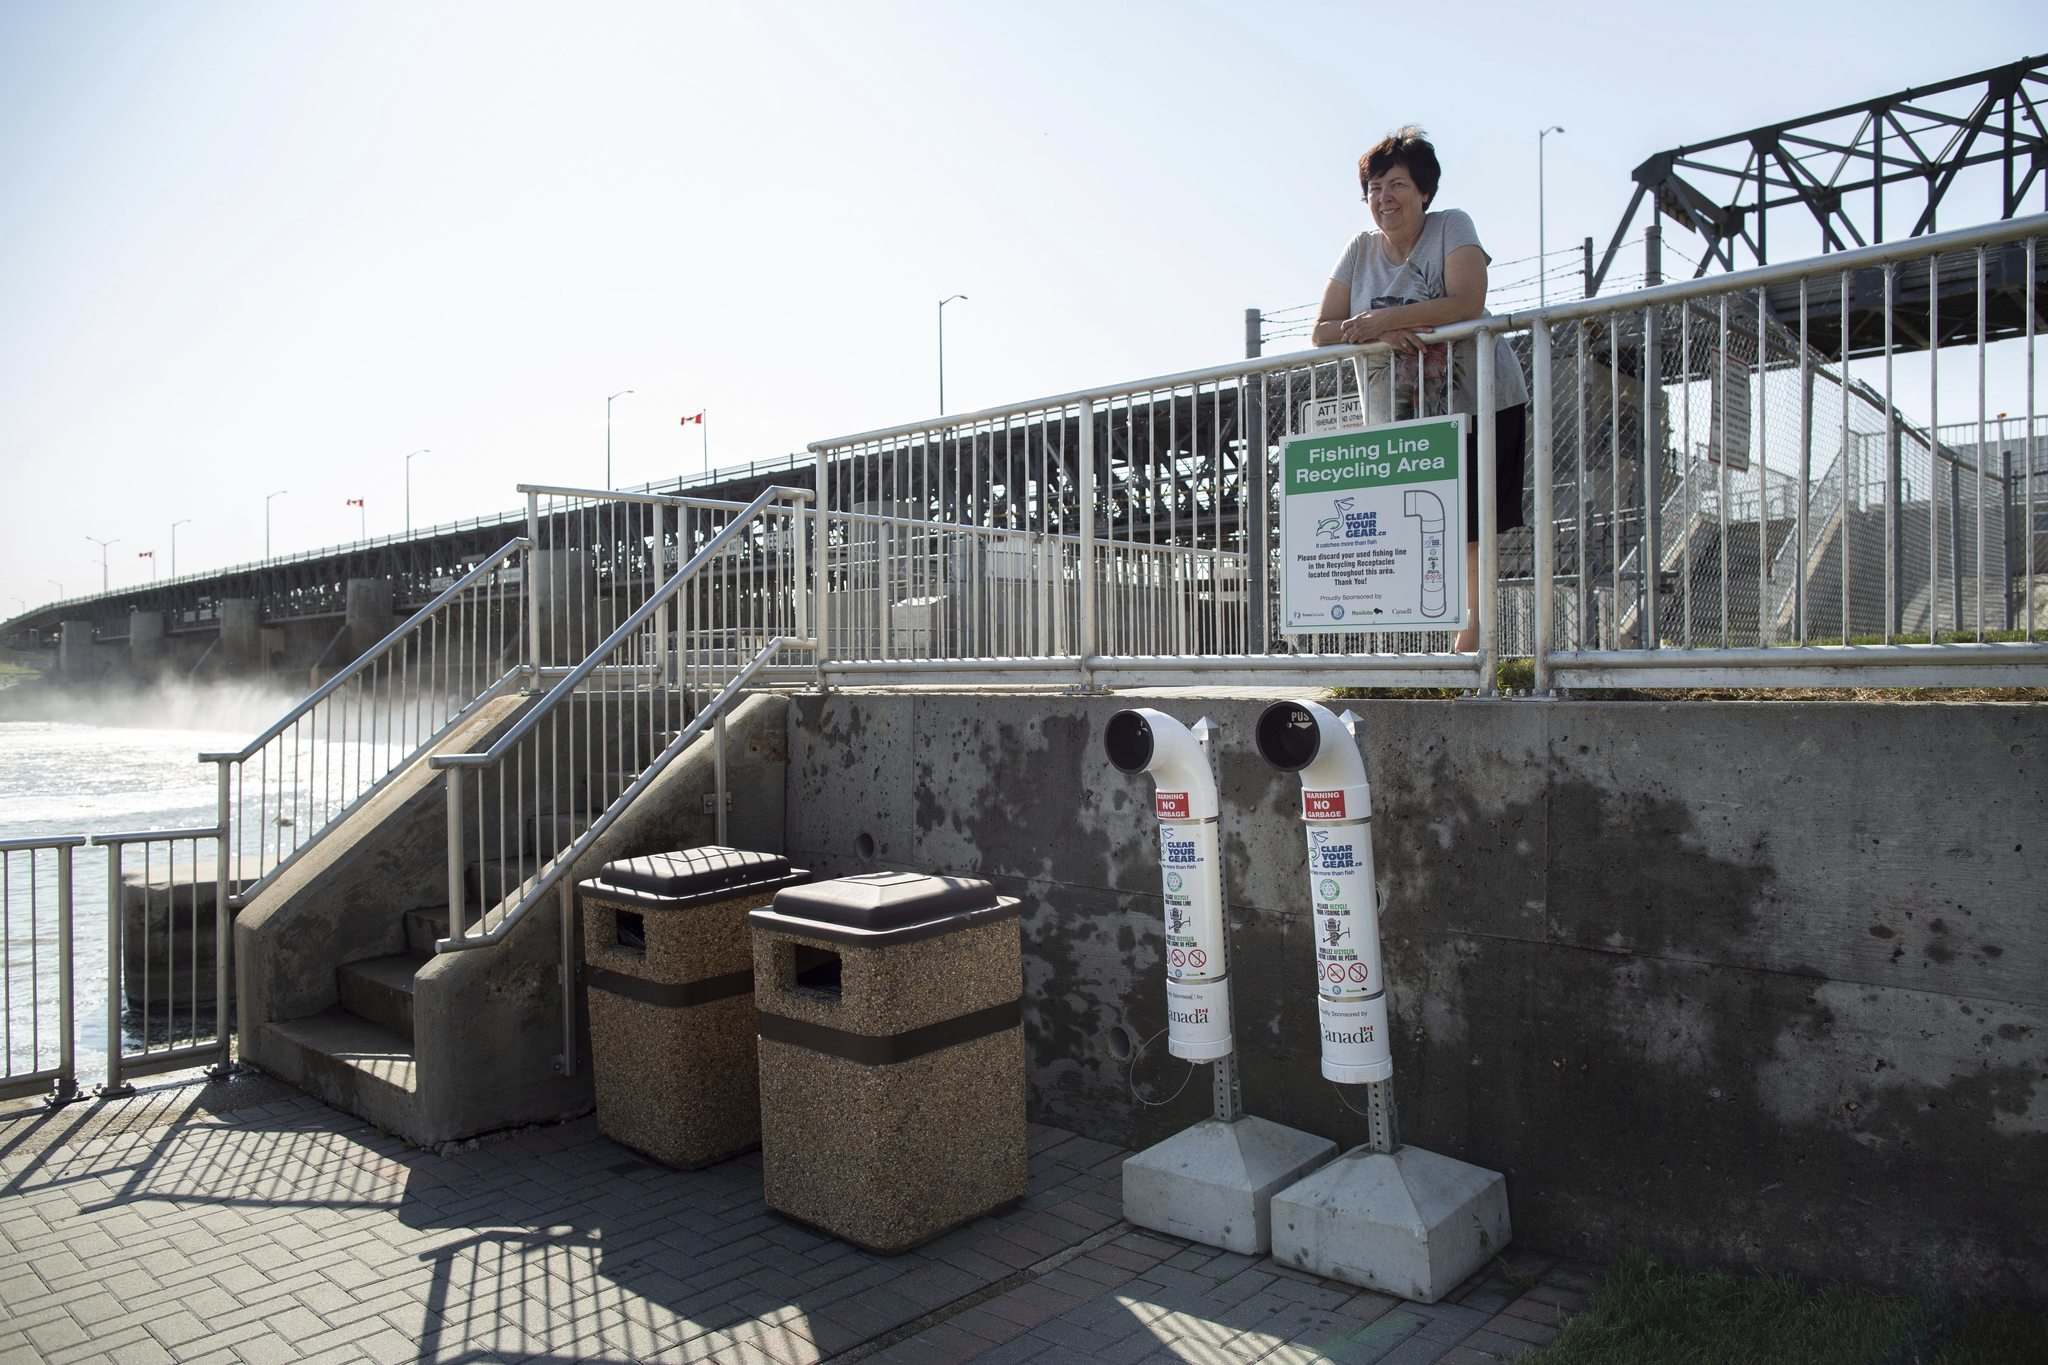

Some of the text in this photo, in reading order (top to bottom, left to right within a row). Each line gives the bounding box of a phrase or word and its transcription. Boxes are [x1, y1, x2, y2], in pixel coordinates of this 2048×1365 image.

[1318, 400, 1362, 416] ATTENT
[1309, 438, 1430, 463] Fishing Line
[1296, 456, 1445, 483] Recycling Area
[1345, 512, 1376, 520] CLEAR
[1345, 520, 1376, 529] YOUR
[1356, 550, 1370, 558] used
[1372, 549, 1393, 557] fishing
[1326, 560, 1355, 569] Recycling
[1357, 559, 1395, 567] Receptacles
[1331, 569, 1364, 577] throughout
[1354, 577, 1367, 585] You!
[1291, 711, 1309, 721] PUS
[1162, 801, 1176, 810] NO
[1313, 800, 1330, 810] NO
[1321, 852, 1353, 860] YOUR
[1168, 1008, 1208, 1024] anada
